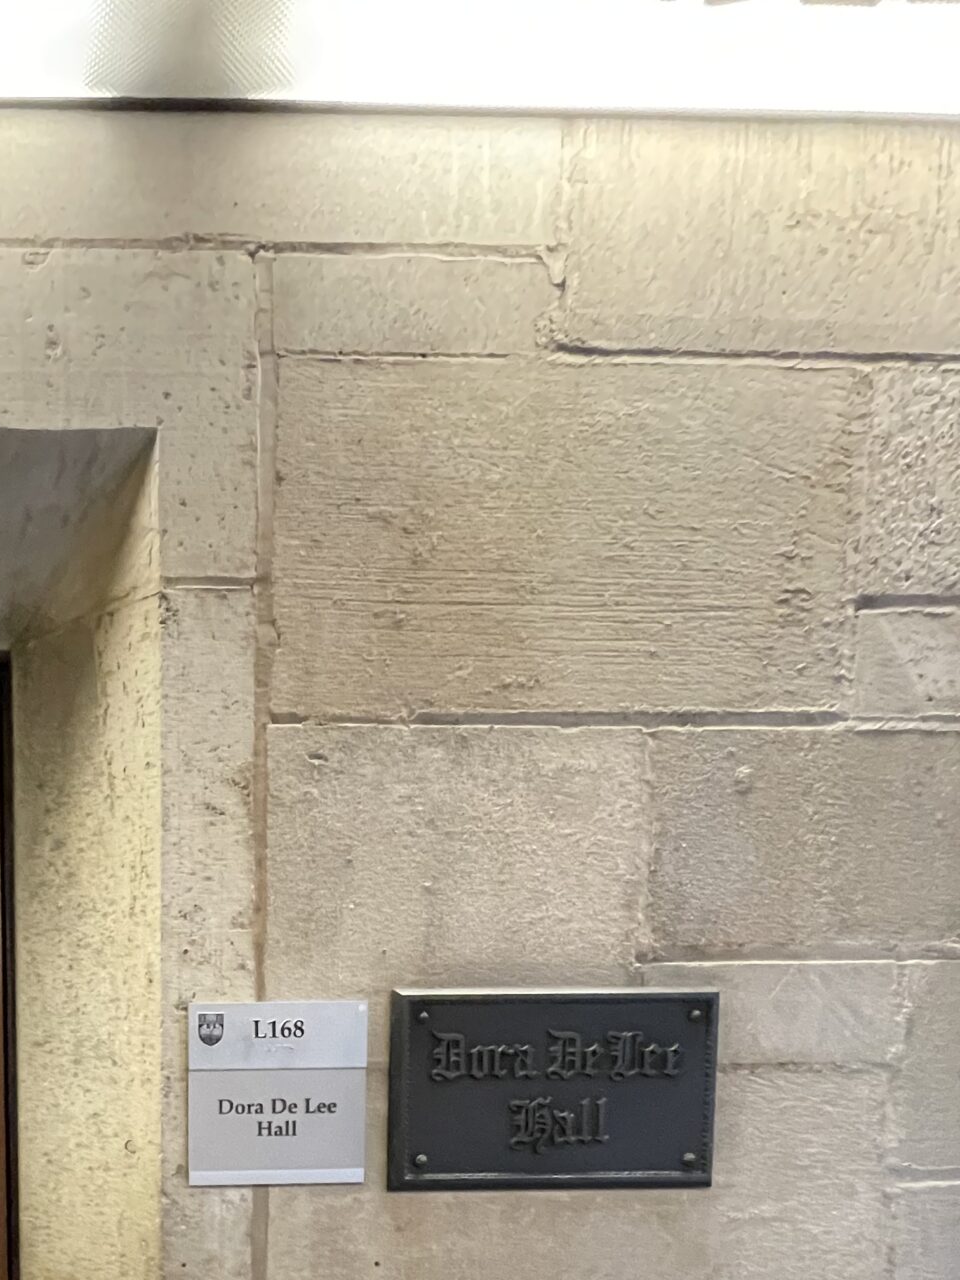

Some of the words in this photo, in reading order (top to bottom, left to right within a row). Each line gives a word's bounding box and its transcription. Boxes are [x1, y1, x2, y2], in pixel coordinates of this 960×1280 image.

[253, 1019, 305, 1039] L168
[432, 1029, 540, 1081] Dora
[547, 1028, 602, 1080] De
[607, 1030, 681, 1081] Lee
[218, 1099, 264, 1115] Dora
[271, 1098, 298, 1114] De
[304, 1097, 338, 1114] Lee
[256, 1119, 298, 1137] Hall
[510, 1096, 610, 1153] Hall
